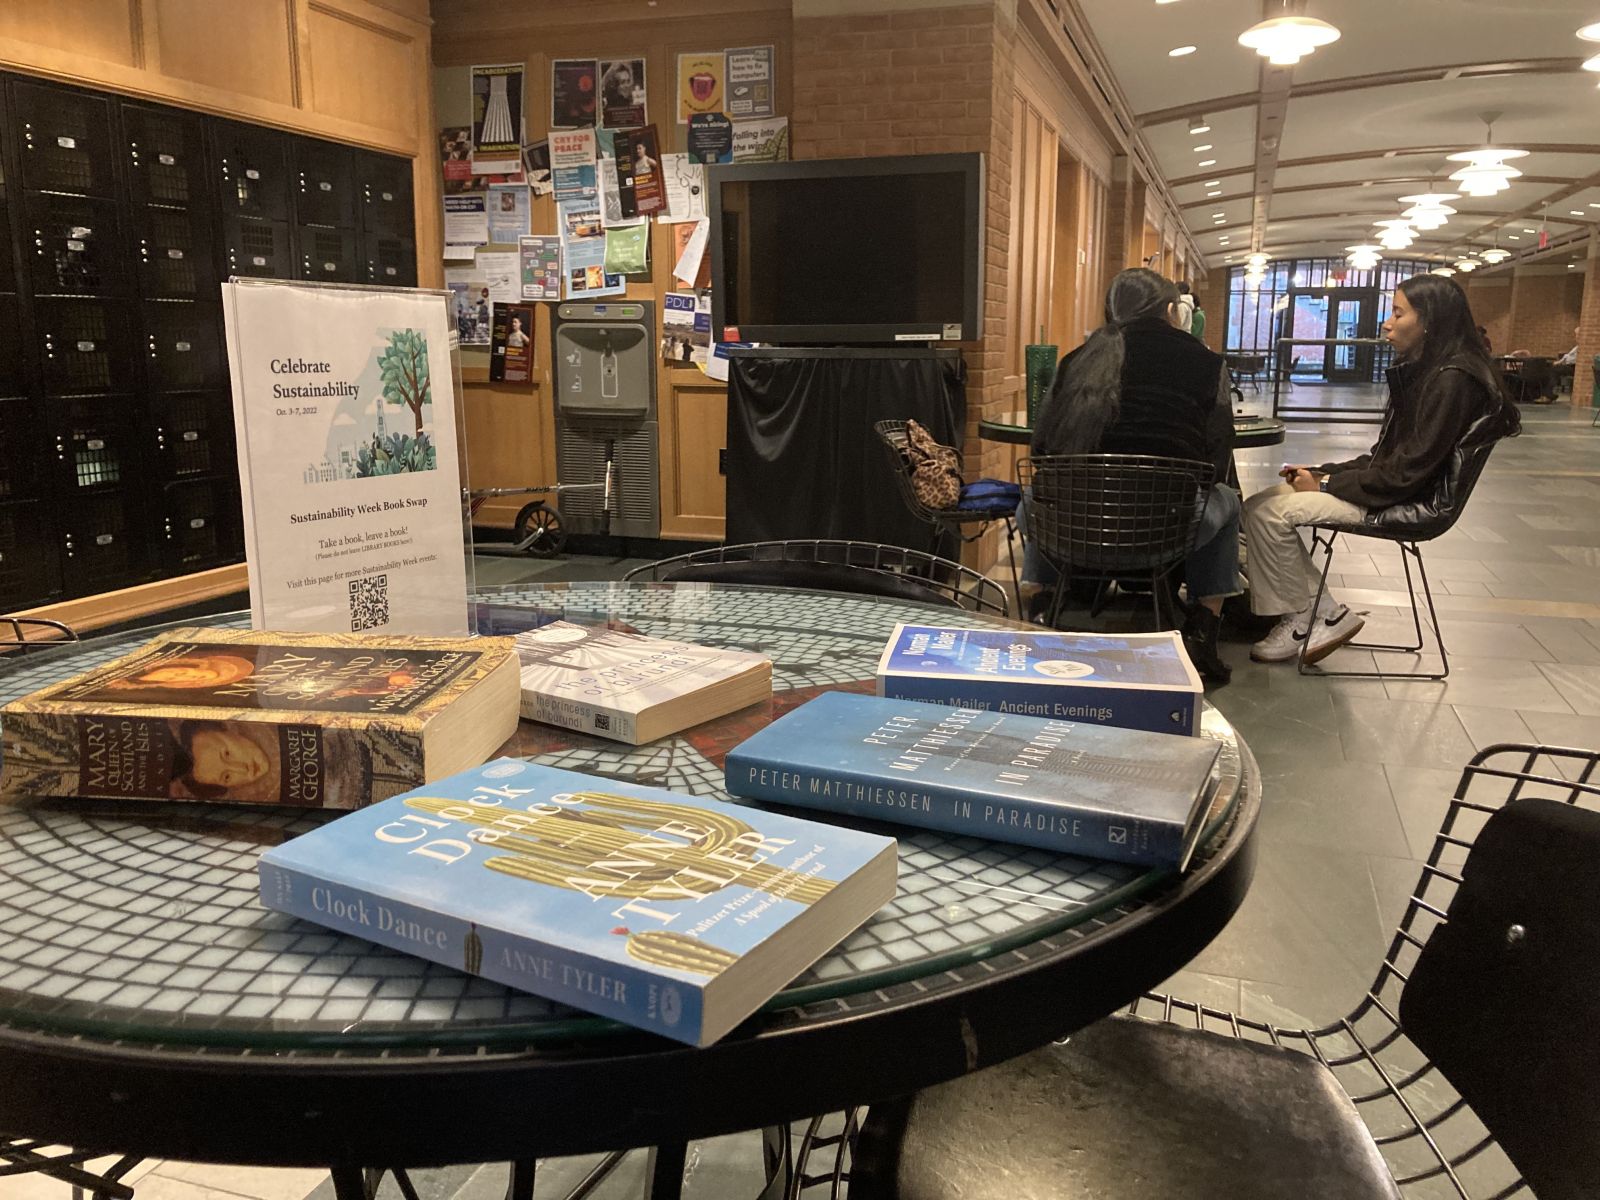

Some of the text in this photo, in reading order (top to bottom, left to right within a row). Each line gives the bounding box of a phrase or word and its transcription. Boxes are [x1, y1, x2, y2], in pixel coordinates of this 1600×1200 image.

[554, 134, 591, 144] CRY FOR
[554, 144, 583, 153] PEACE
[760, 128, 775, 138] into
[270, 357, 331, 374] Celebrate
[273, 381, 360, 401] Sustainability
[290, 497, 428, 524] Sustainability Week Book Swap
[318, 537, 338, 549] Take
[344, 533, 364, 545] book,
[365, 531, 383, 541] leave
[389, 526, 408, 537] book!
[286, 553, 439, 589] Visit this page for more Sustainability Week events:
[213, 652, 317, 697] MARY
[421, 652, 463, 678] GEORGE
[556, 645, 690, 692] the princess
[610, 656, 697, 688] burundi
[863, 715, 919, 746] PETER
[949, 698, 992, 711] Mailer
[1000, 701, 1051, 716] Ancient
[1053, 703, 1113, 721] Evenings
[85, 718, 106, 788] MARY
[120, 721, 135, 792] SCOTLAND
[135, 722, 150, 752] ISLES
[888, 708, 984, 773] MATTHIESSEN
[1010, 720, 1076, 769] PARADISE
[107, 740, 121, 786] QUEEN
[287, 728, 301, 799] MARGARET
[300, 729, 319, 801] GEORGE
[994, 771, 1031, 787] IN
[374, 783, 536, 844] Clock
[749, 766, 1082, 838] PETER MATTHIESSEN IN PARADISE
[407, 792, 586, 866] Dance
[564, 819, 718, 903] ANNE
[610, 831, 797, 926] TYLER
[684, 907, 732, 938] Pulitzer
[788, 850, 817, 871] author
[739, 899, 772, 920] Spool
[311, 886, 371, 927] Clock
[377, 905, 448, 950] Dance
[733, 914, 747, 927] A
[500, 947, 627, 1005] ANNE TYLER
